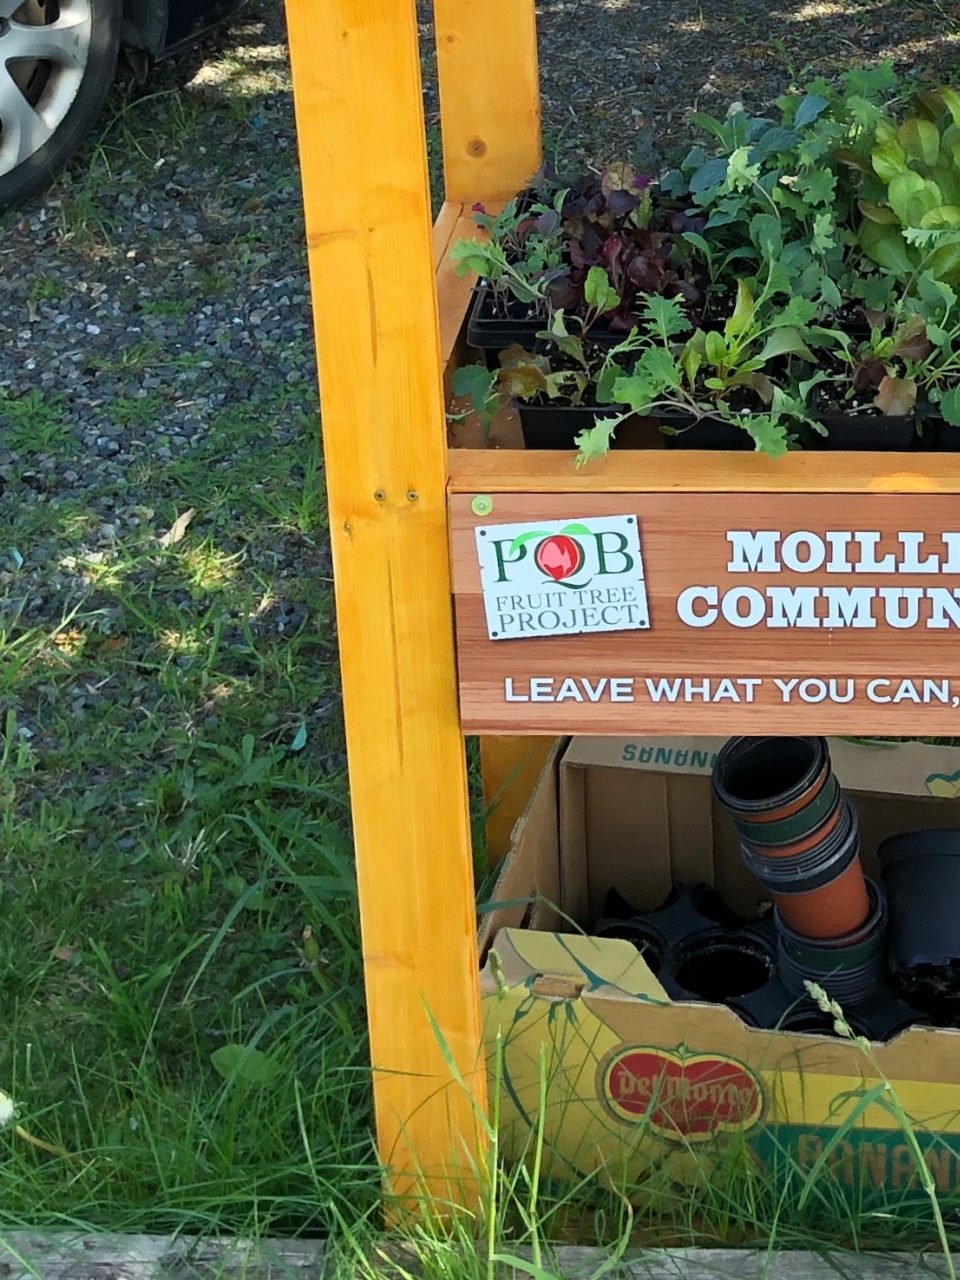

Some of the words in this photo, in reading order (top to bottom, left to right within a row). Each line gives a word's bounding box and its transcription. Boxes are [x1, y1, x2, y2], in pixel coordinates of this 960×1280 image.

[495, 590, 572, 612] FRUIT
[573, 586, 638, 606] TREE
[499, 604, 640, 634] PROJECT
[504, 676, 634, 703] LEAVE
[644, 676, 761, 703] WHAT
[770, 677, 855, 704] YOU
[865, 677, 960, 708] CAN,
[622, 744, 721, 769] NANAS
